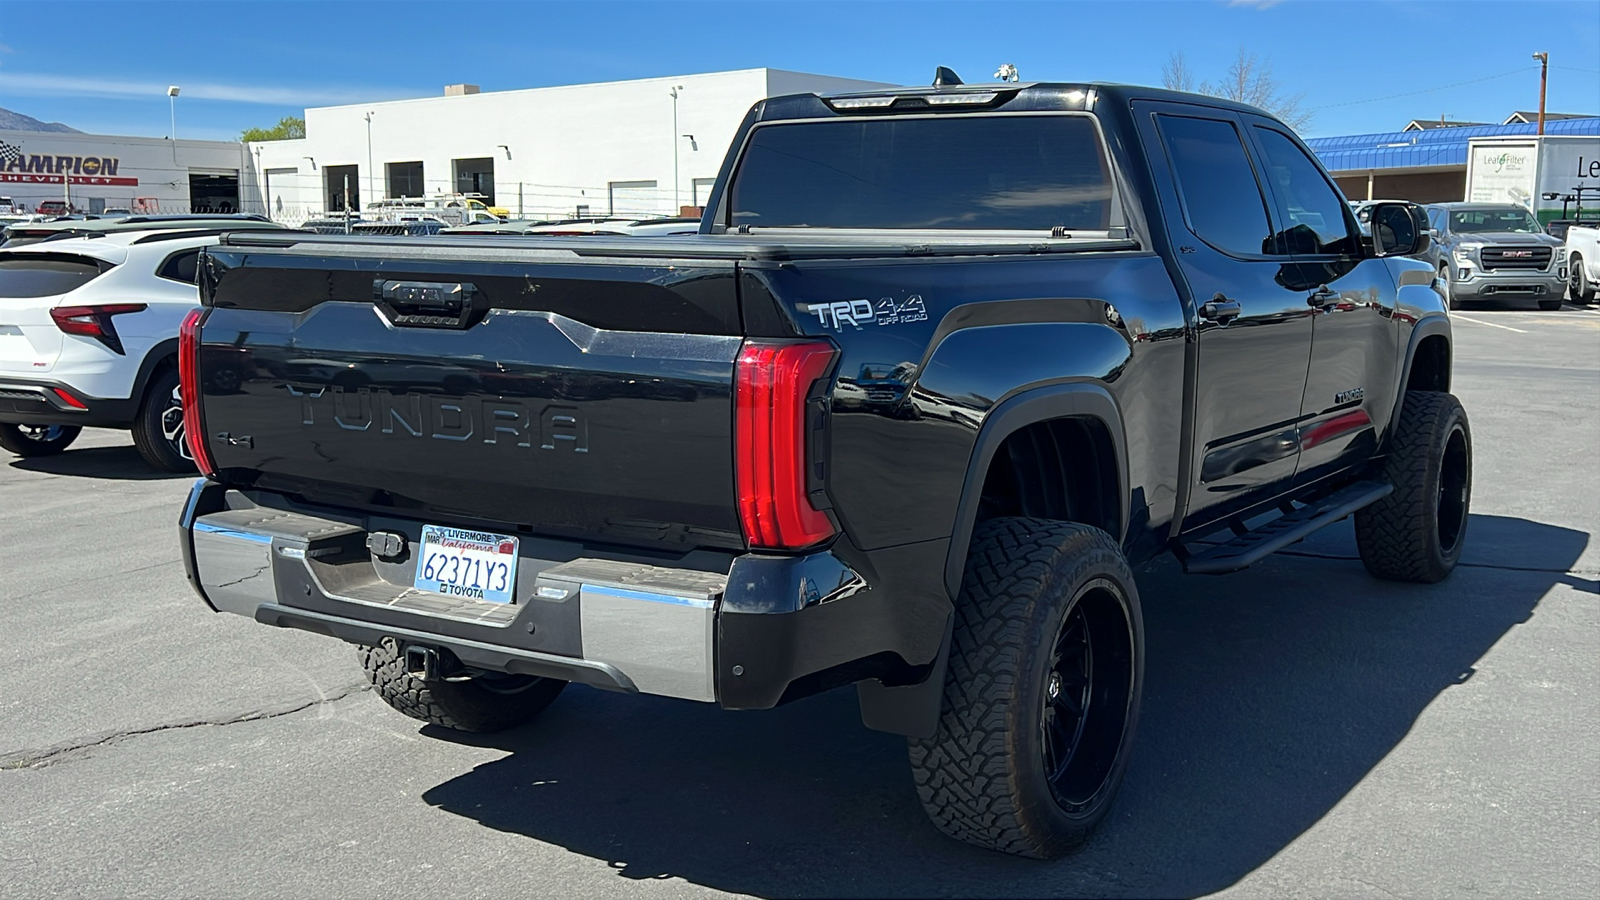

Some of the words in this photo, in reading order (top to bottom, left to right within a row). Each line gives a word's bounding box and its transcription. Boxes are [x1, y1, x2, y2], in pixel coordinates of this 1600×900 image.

[807, 299, 875, 331] TRD
[878, 316, 899, 326] OFF
[901, 314, 928, 323] ROAD
[286, 383, 588, 453] TUNDRA
[427, 534, 440, 544] MAR
[448, 529, 492, 543] LIVERMORE
[441, 537, 495, 555] California
[424, 552, 509, 592] 62371Y3
[449, 584, 484, 599] TOYOTA
